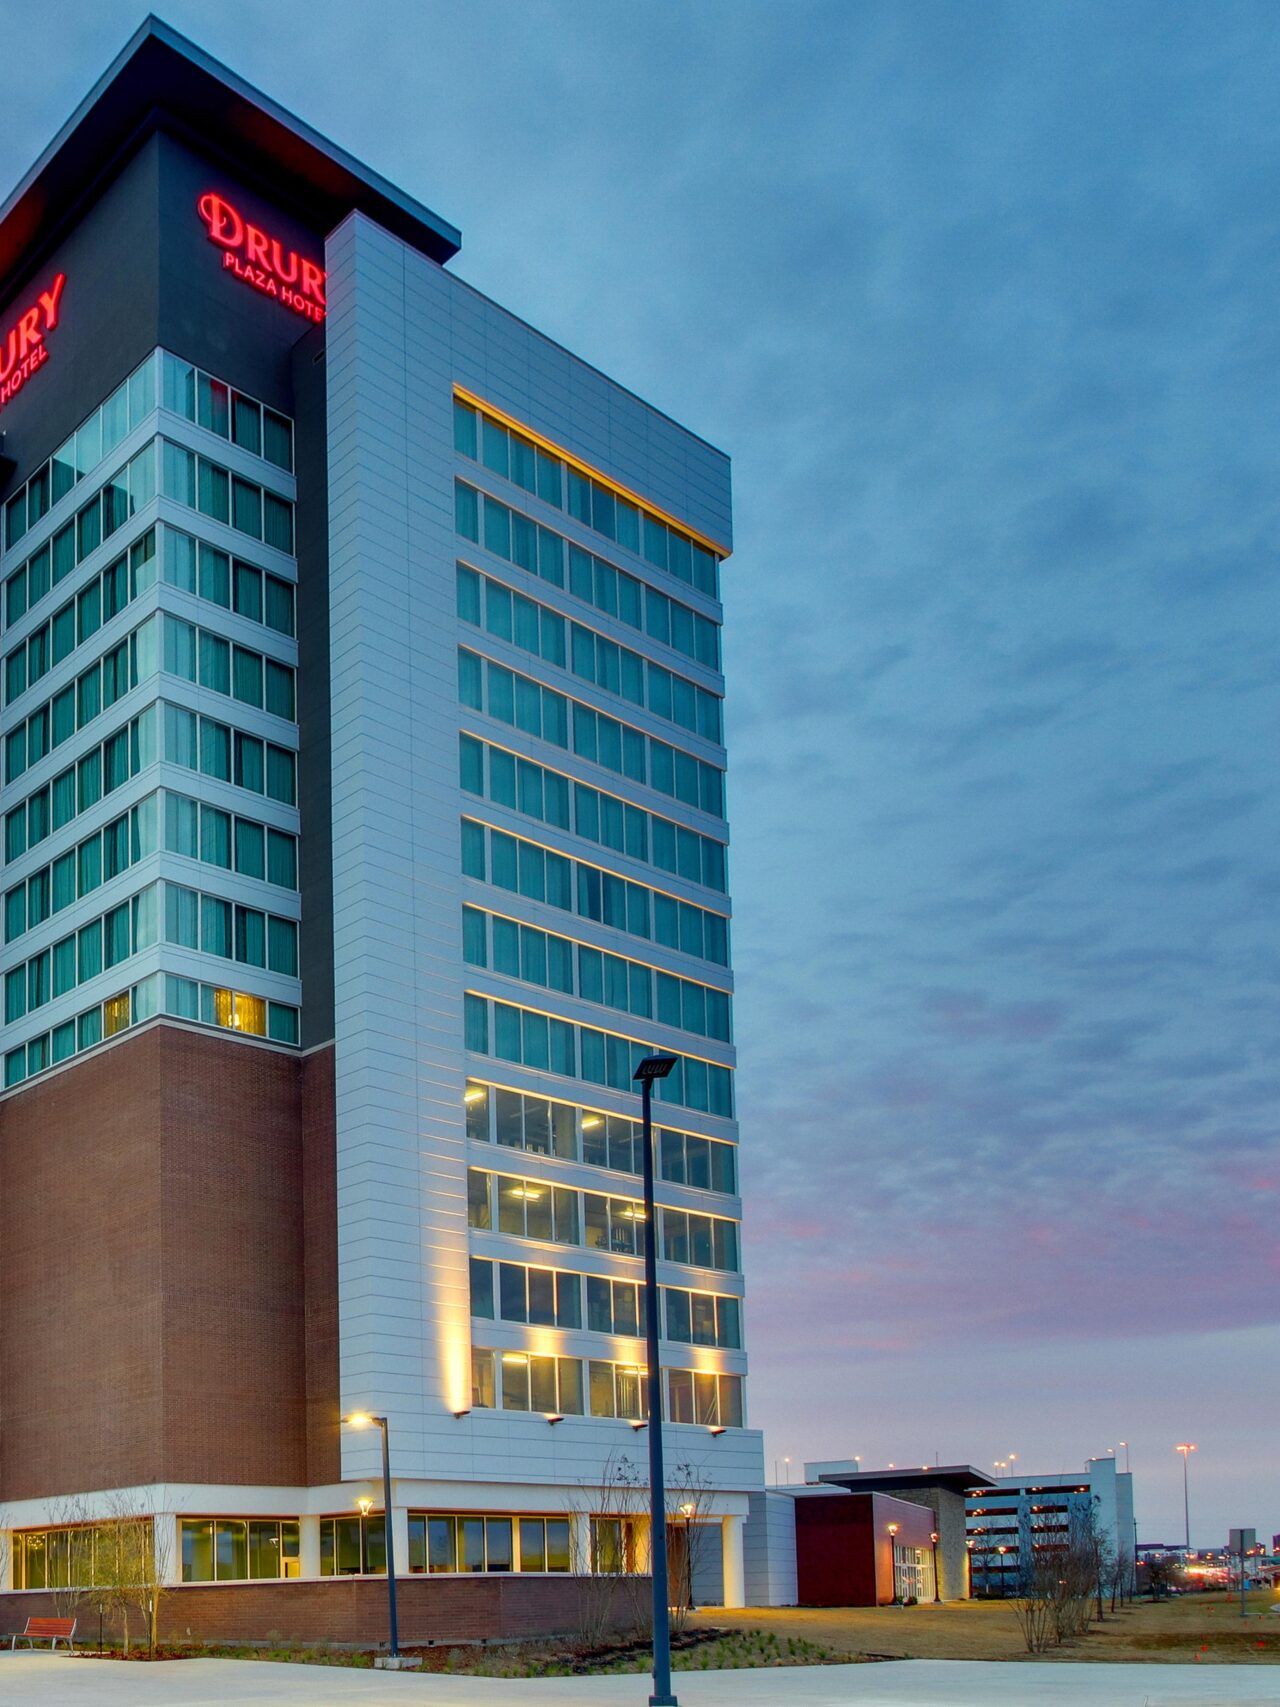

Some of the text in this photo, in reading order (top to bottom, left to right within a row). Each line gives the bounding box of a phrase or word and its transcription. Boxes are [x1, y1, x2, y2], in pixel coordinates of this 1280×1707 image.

[197, 193, 328, 305] DRUR
[224, 251, 328, 322] PLAZA HOTE
[1, 344, 49, 403] HOTEL
